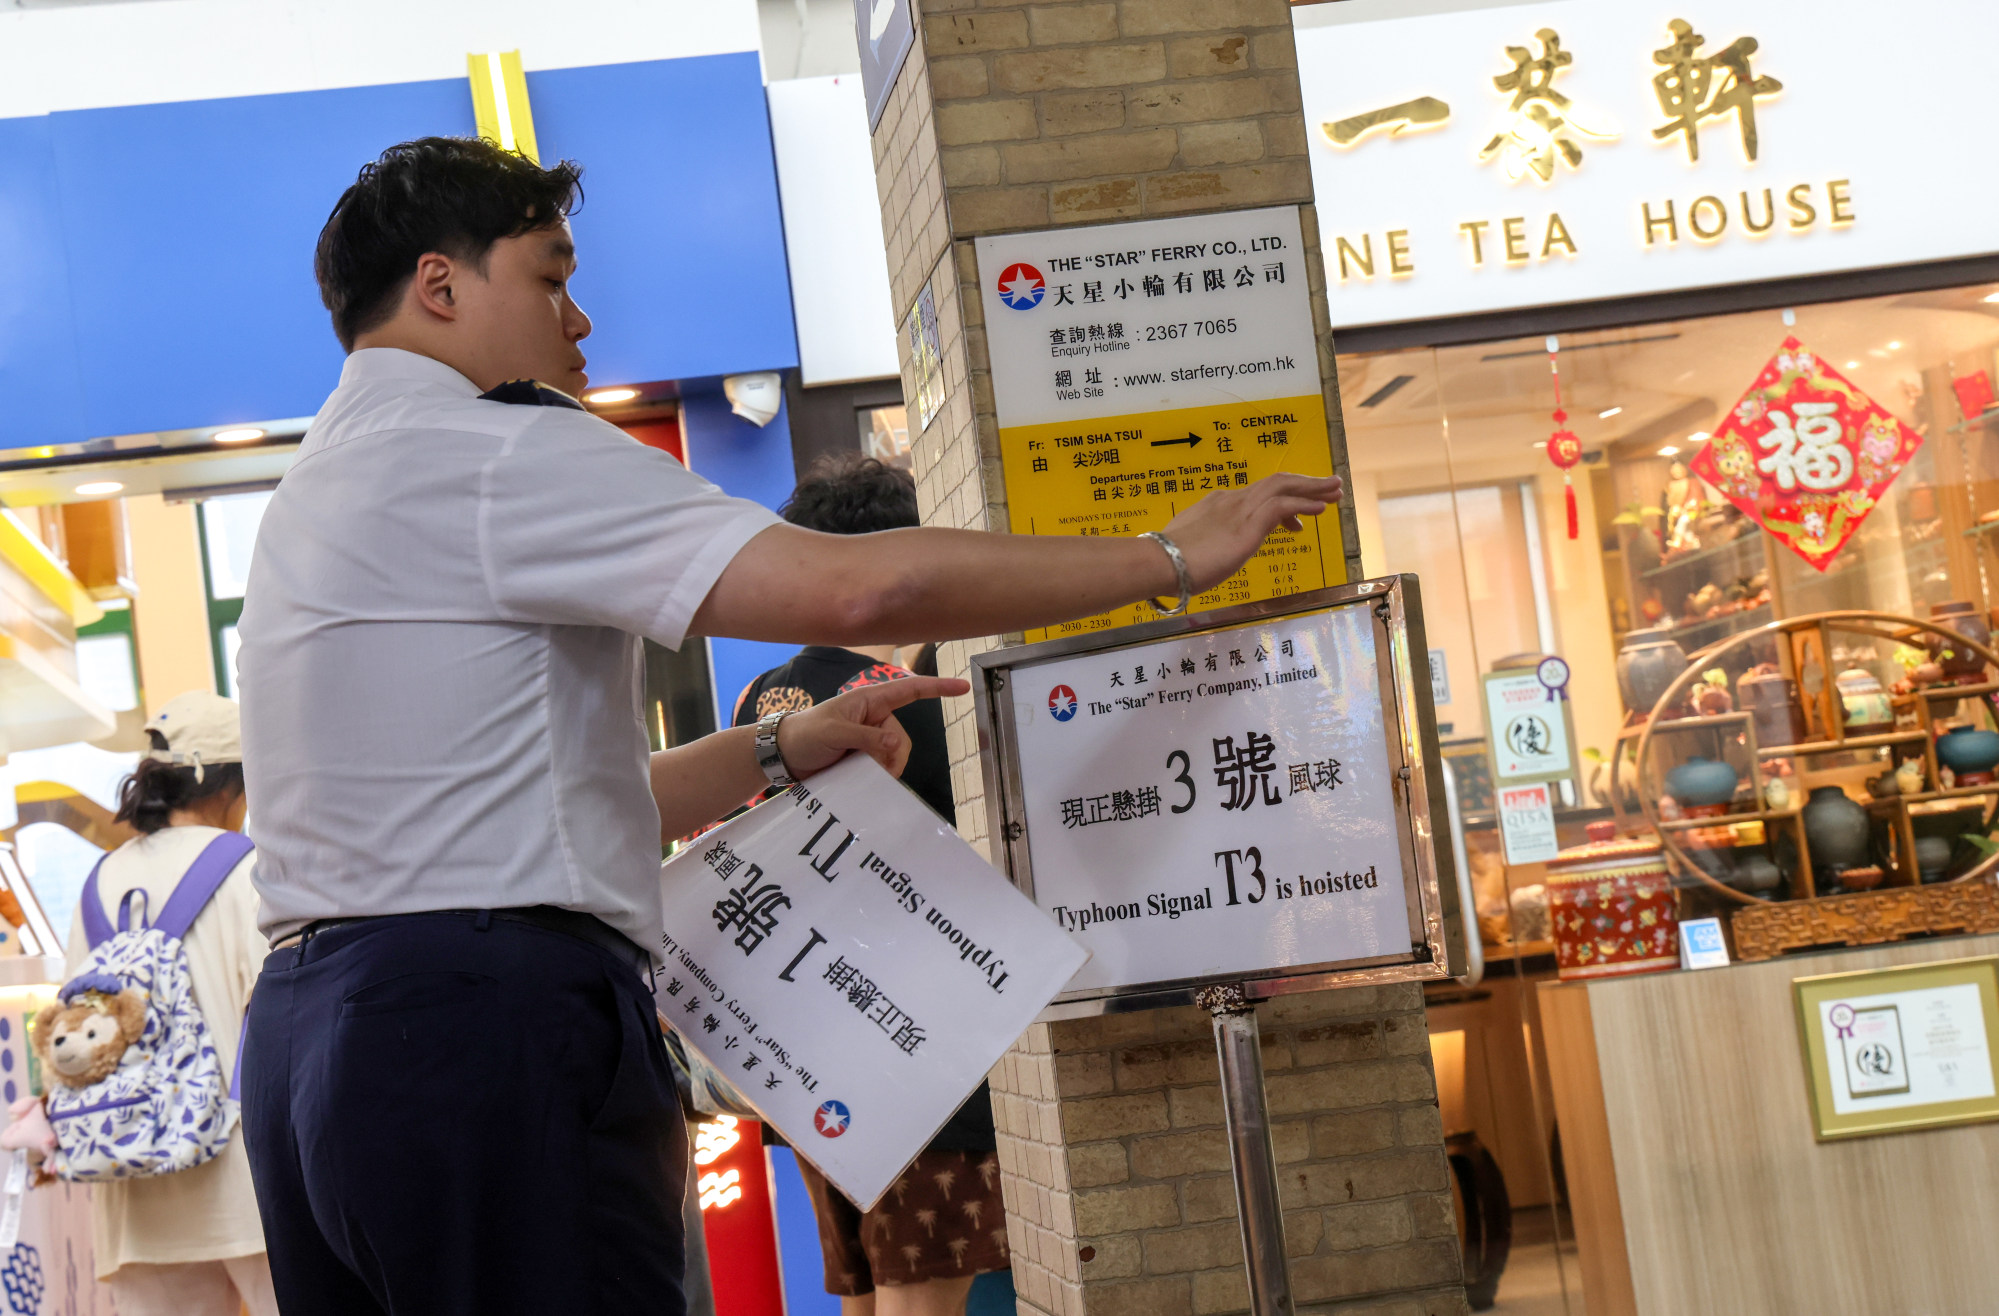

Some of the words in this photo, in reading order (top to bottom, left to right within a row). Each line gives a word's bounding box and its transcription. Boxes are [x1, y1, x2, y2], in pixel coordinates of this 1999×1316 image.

[1335, 229, 1414, 280] NE
[1460, 212, 1578, 265] TEA
[1642, 179, 1856, 244] HOUSE
[1048, 256, 1082, 273] THE
[1085, 250, 1146, 269] “STAR”
[1151, 244, 1207, 262] FERRY
[1212, 240, 1247, 256] CO.,
[1252, 236, 1287, 252] LTD.
[1052, 262, 1287, 307] 天星小輪有限公司
[1050, 323, 1125, 346] 查詢熱線
[1146, 324, 1188, 342] 2367
[1194, 318, 1238, 337] 7065
[1051, 342, 1090, 358] Enquiry
[1094, 340, 1130, 354] Hotline
[1057, 391, 1080, 401] Web
[1084, 388, 1104, 399] Site
[1213, 420, 1231, 431] To:
[1241, 413, 1298, 428] CENTRAL
[1029, 440, 1045, 451] Fr:
[1054, 436, 1083, 448] TSIM
[1087, 433, 1112, 445] SHA
[1115, 430, 1143, 441] TSUI
[1217, 437, 1233, 453] 往
[1257, 430, 1288, 448] 中環
[1758, 402, 1854, 490] 福
[1032, 456, 1048, 472] 由
[1073, 449, 1120, 468] 尖沙咀
[1090, 471, 1145, 487] Departures
[1149, 468, 1175, 479] From
[1178, 464, 1201, 475] Tsim
[1204, 462, 1224, 472] Sha
[1227, 460, 1248, 470] Tsui
[1094, 471, 1248, 501] 由尖沙咀開出之時間
[1058, 514, 1099, 525] MONDAYS
[1101, 512, 1112, 520] TO
[1113, 509, 1148, 519] FRIDAYS
[1080, 524, 1131, 536] 星期一至五
[1269, 565, 1278, 573] 10
[1287, 563, 1297, 571] 12
[1200, 595, 1220, 605] 2230
[1229, 591, 1250, 601] 2330
[1228, 580, 1249, 590] 2230
[1060, 621, 1081, 632] 2030
[1090, 619, 1111, 628] 2330
[1110, 639, 1294, 688] 天星小輪有限公司
[1088, 700, 1113, 717] The
[1115, 692, 1155, 711] “Star”
[1158, 685, 1193, 707] Ferry
[1197, 676, 1262, 699] Company,
[1265, 664, 1317, 686] Limited
[1061, 785, 1162, 829] 現正懸掛
[1166, 750, 1197, 814] 3
[1212, 731, 1283, 812] 號
[1287, 758, 1344, 797] 風球
[806, 798, 823, 819] is
[703, 839, 745, 882] 風球
[798, 812, 860, 883] T1
[859, 851, 927, 914] Signal
[1053, 900, 1141, 933] Typhoon
[1147, 887, 1213, 921] Signal
[1215, 845, 1267, 907] T3
[1276, 878, 1293, 901] is
[1299, 866, 1378, 898] hoisted
[712, 863, 792, 957] 號
[778, 927, 828, 983] 1
[927, 908, 1011, 995] Typhoon
[678, 948, 726, 1003] Company,
[724, 999, 759, 1035] Ferry
[822, 954, 927, 1057] 現正懸掛
[795, 1066, 821, 1094] The
